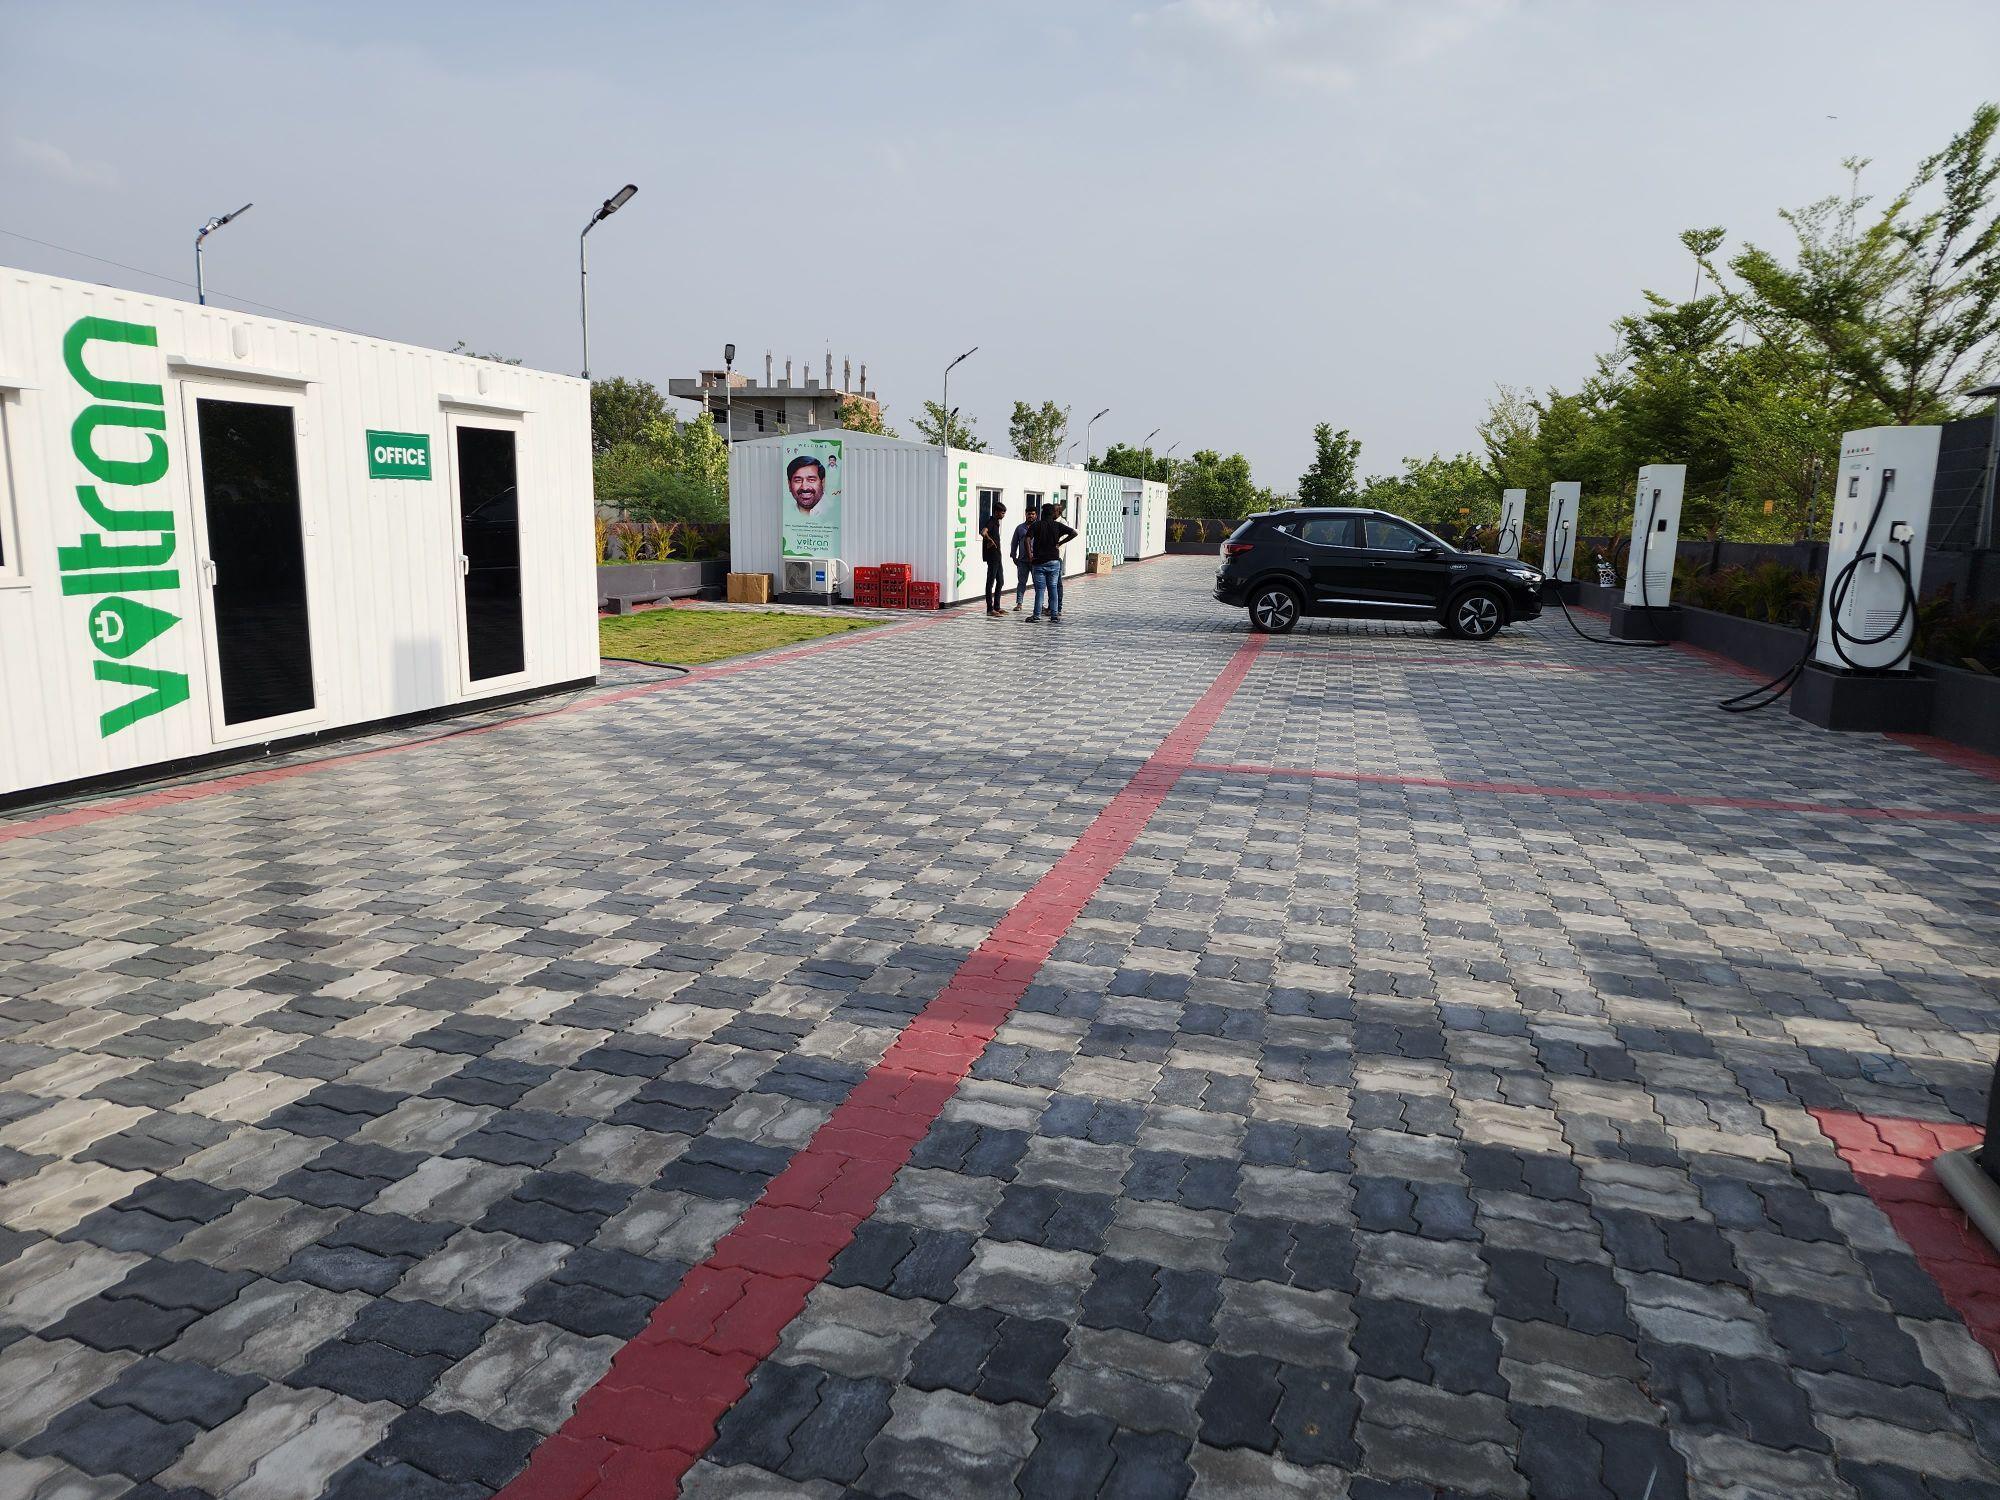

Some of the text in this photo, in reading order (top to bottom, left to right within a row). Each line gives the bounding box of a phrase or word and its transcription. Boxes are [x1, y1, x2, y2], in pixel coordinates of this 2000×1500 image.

[374, 446, 427, 466] OFFICE
[57, 315, 190, 739] voltran
[954, 461, 967, 588] voltran
